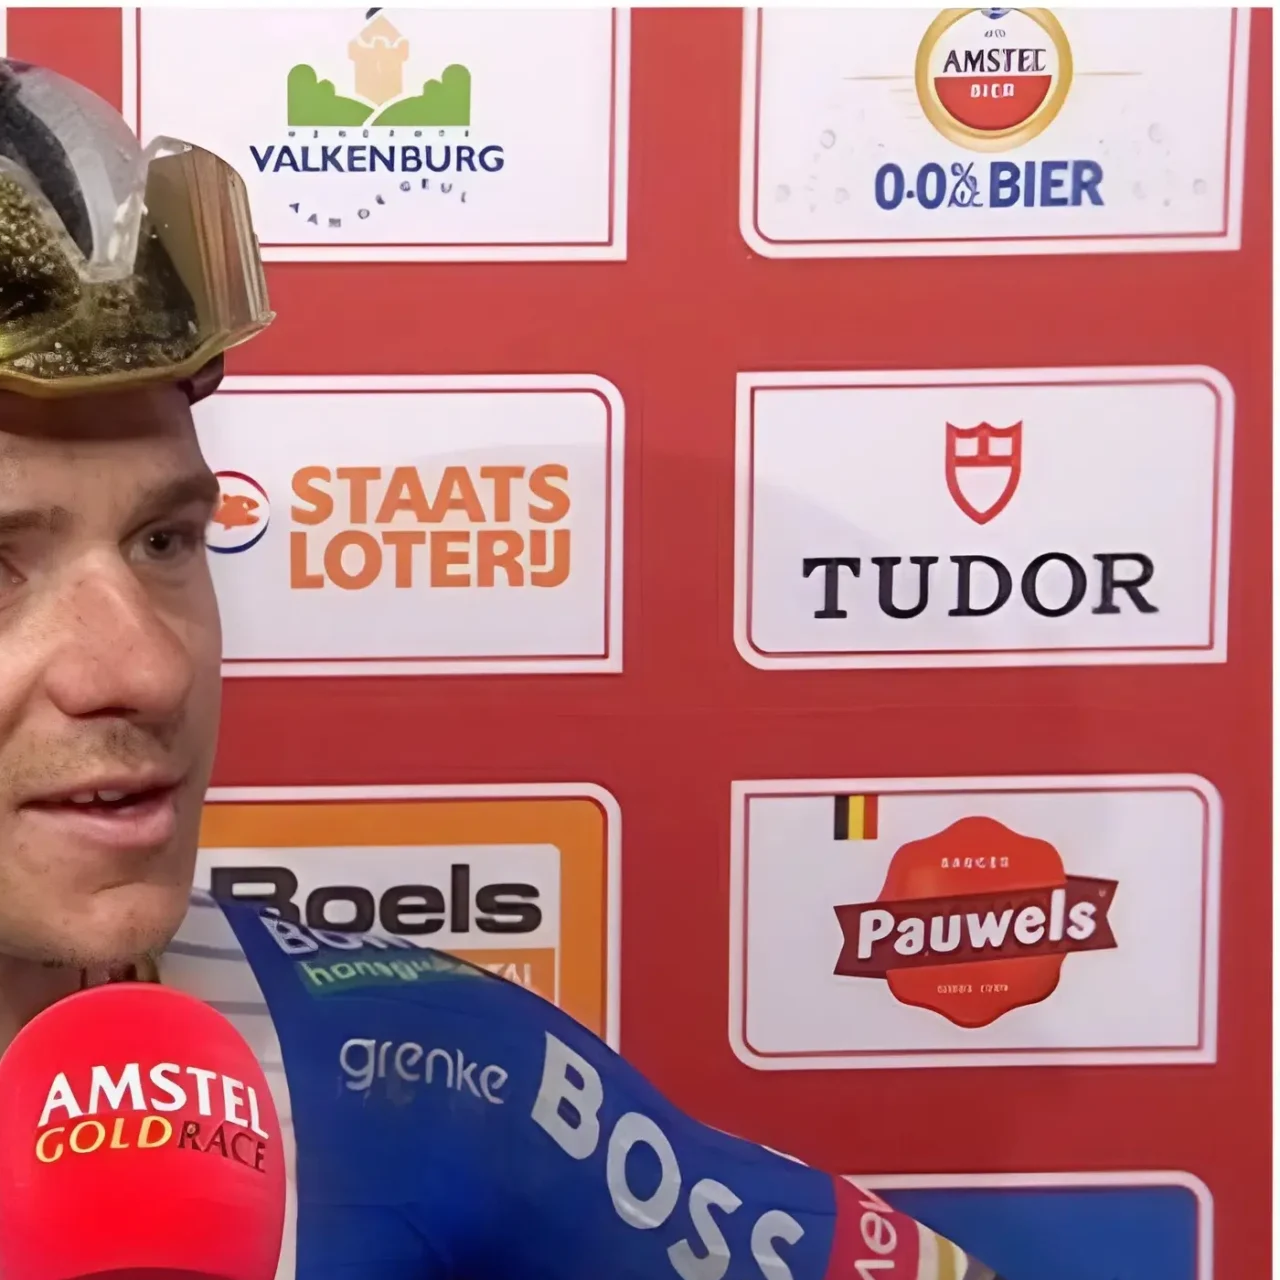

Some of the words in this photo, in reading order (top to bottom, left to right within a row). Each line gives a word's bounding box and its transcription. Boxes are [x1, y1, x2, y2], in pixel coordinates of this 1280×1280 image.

[249, 144, 505, 173] VALKENBURG
[989, 160, 1105, 208] BIER
[290, 464, 571, 525] STAATS
[289, 529, 571, 591] LOTERIJ
[801, 551, 1160, 620] TUDOR
[857, 888, 1098, 960] Pauwels
[37, 1062, 270, 1140] AMSTEL
[339, 1038, 509, 1105] grenke
[35, 1115, 173, 1164] GOLD
[177, 1119, 267, 1174] RACE
